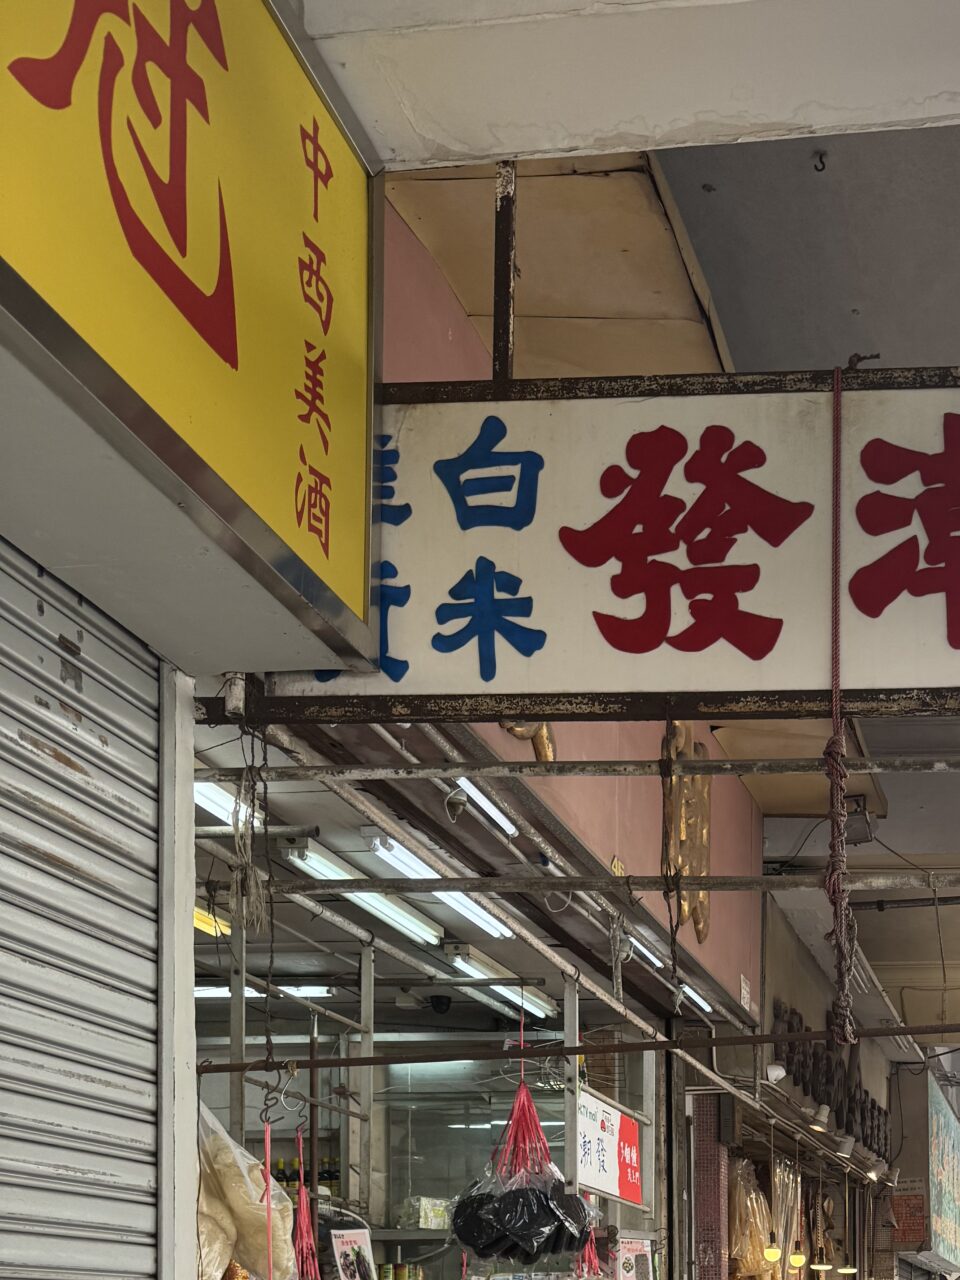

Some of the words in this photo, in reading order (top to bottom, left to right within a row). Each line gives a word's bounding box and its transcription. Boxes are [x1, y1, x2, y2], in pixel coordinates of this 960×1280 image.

[294, 114, 334, 560] 中西美酒
[431, 415, 547, 683] 白米
